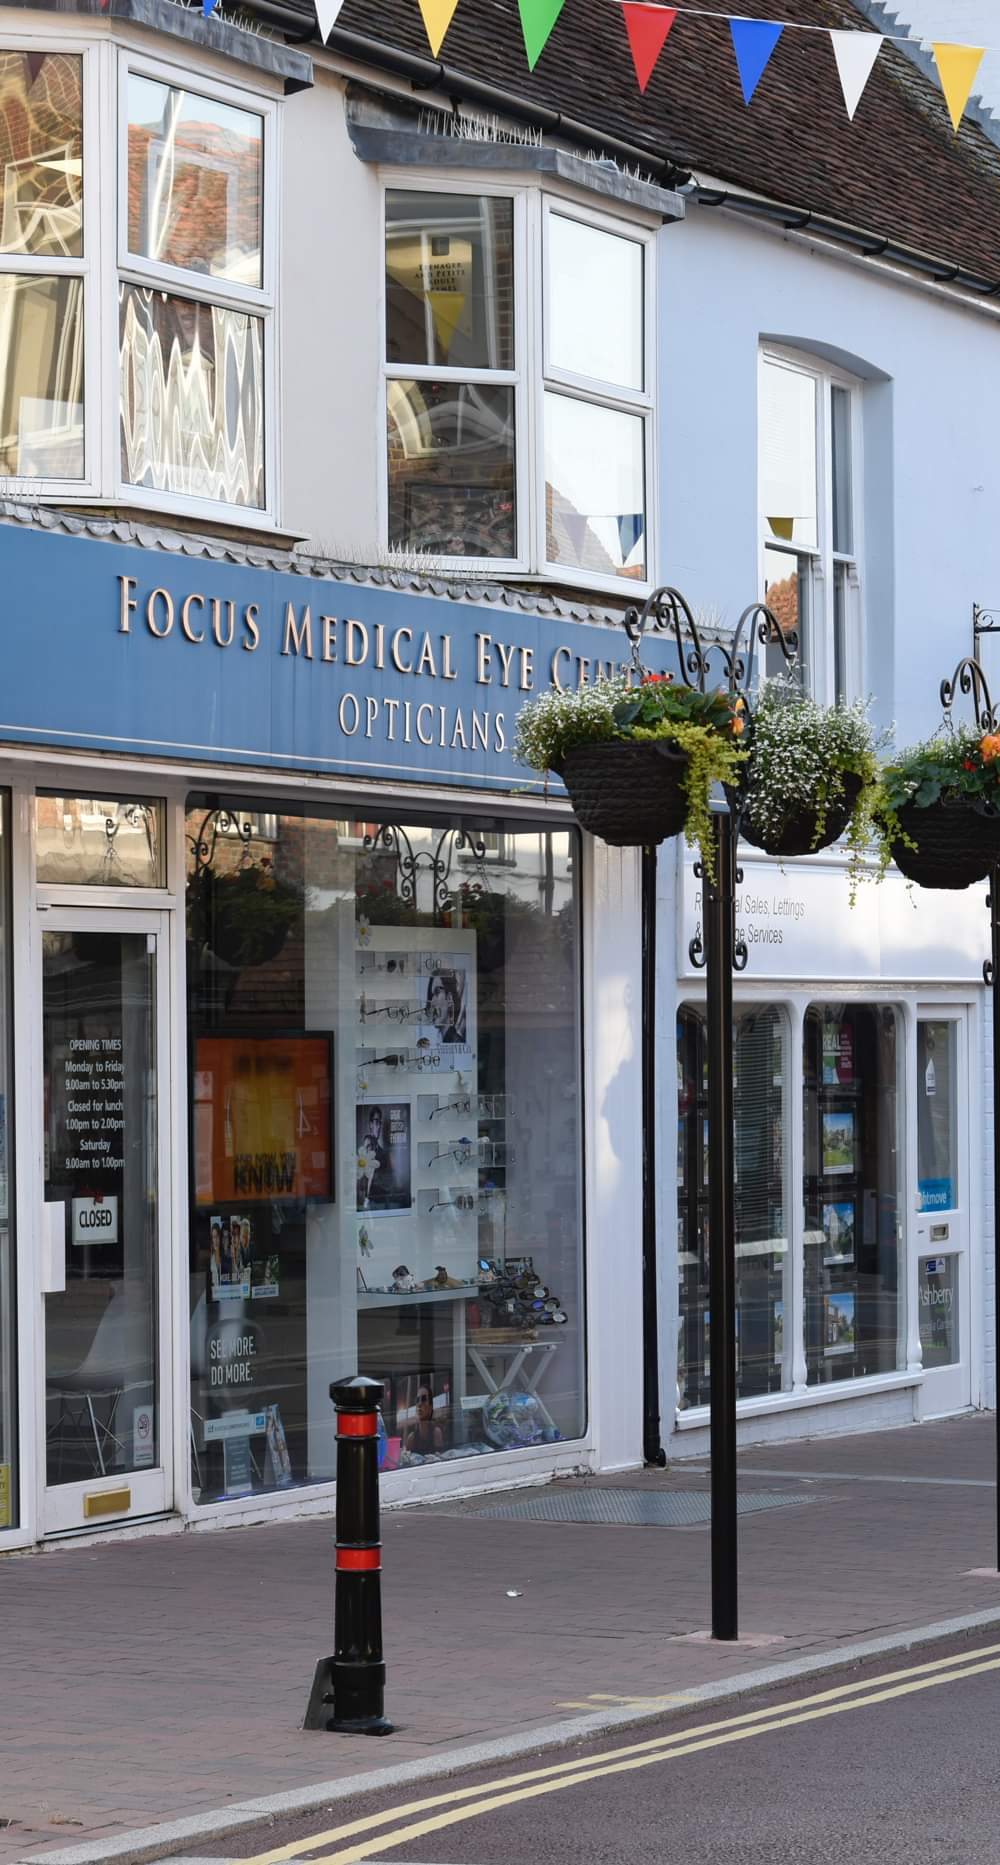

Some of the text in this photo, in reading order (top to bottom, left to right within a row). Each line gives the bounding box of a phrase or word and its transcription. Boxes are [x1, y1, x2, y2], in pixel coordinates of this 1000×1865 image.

[116, 575, 676, 696] FOCUS MEDICAL EYE CENT
[338, 692, 506, 753] OPTICIANS
[773, 896, 806, 920] Lettings
[747, 923, 784, 944] Services
[69, 1039, 122, 1050] OPENING TIMES
[65, 1060, 126, 1075] Monday to Friday
[65, 1079, 126, 1092] 9.00am to 5.30pm
[67, 1099, 124, 1112] Closed for lunch
[66, 1118, 126, 1132] 1.00pm to 2.00pm
[80, 1139, 112, 1152] Saturday
[65, 1158, 91, 1169] 9.00am
[92, 1158, 100, 1168] to
[233, 1164, 296, 1194] KNOW
[79, 1209, 113, 1228] CLOSED
[210, 1338, 227, 1360] SEE
[211, 1362, 253, 1386] DO MORE.
